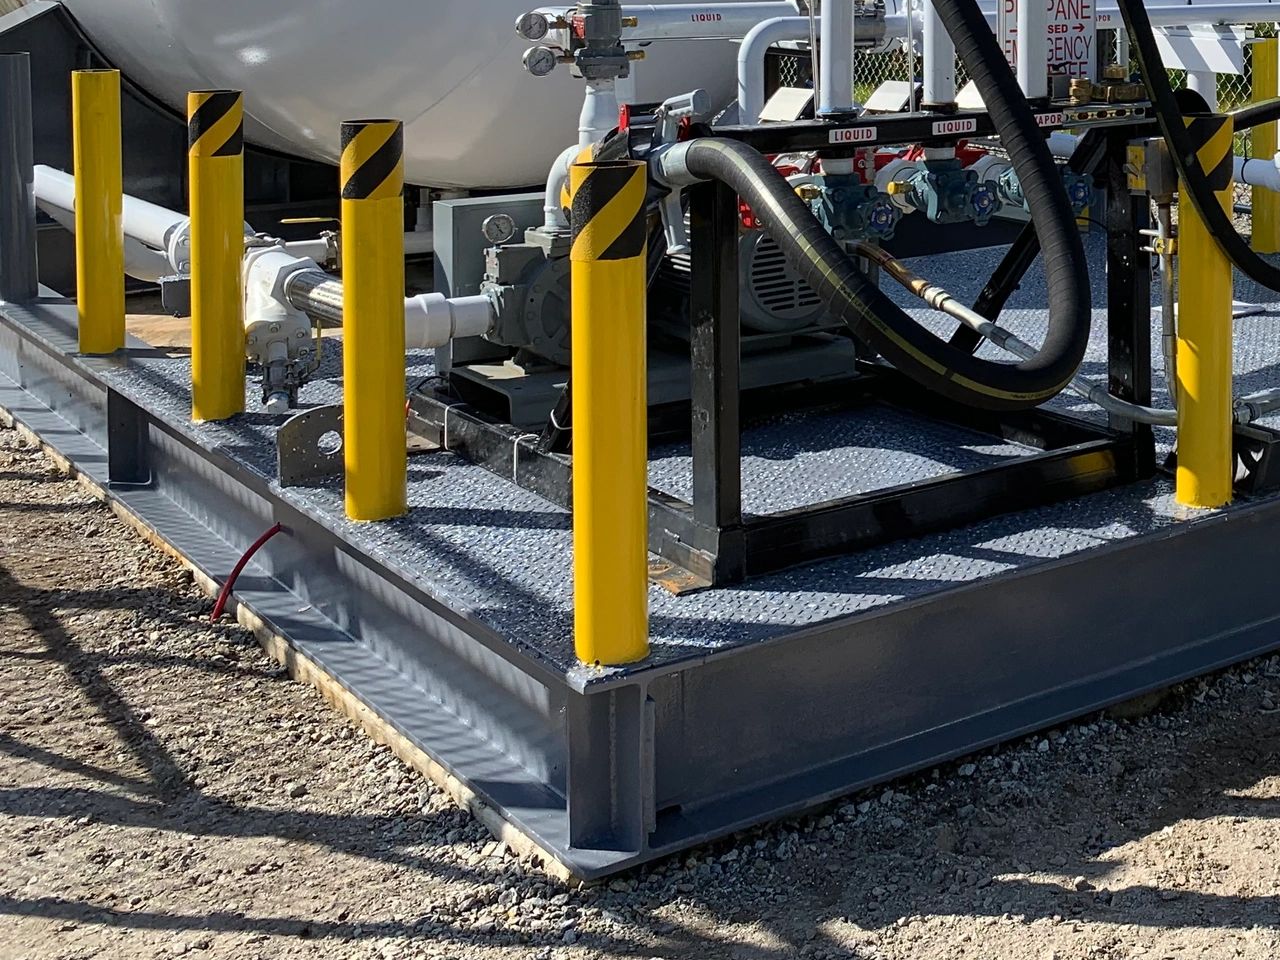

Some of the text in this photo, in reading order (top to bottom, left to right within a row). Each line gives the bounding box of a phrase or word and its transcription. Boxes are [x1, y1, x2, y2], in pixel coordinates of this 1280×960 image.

[691, 13, 722, 22] LIQUID
[937, 120, 972, 133] LIQUID
[834, 128, 872, 141] LIQUID
